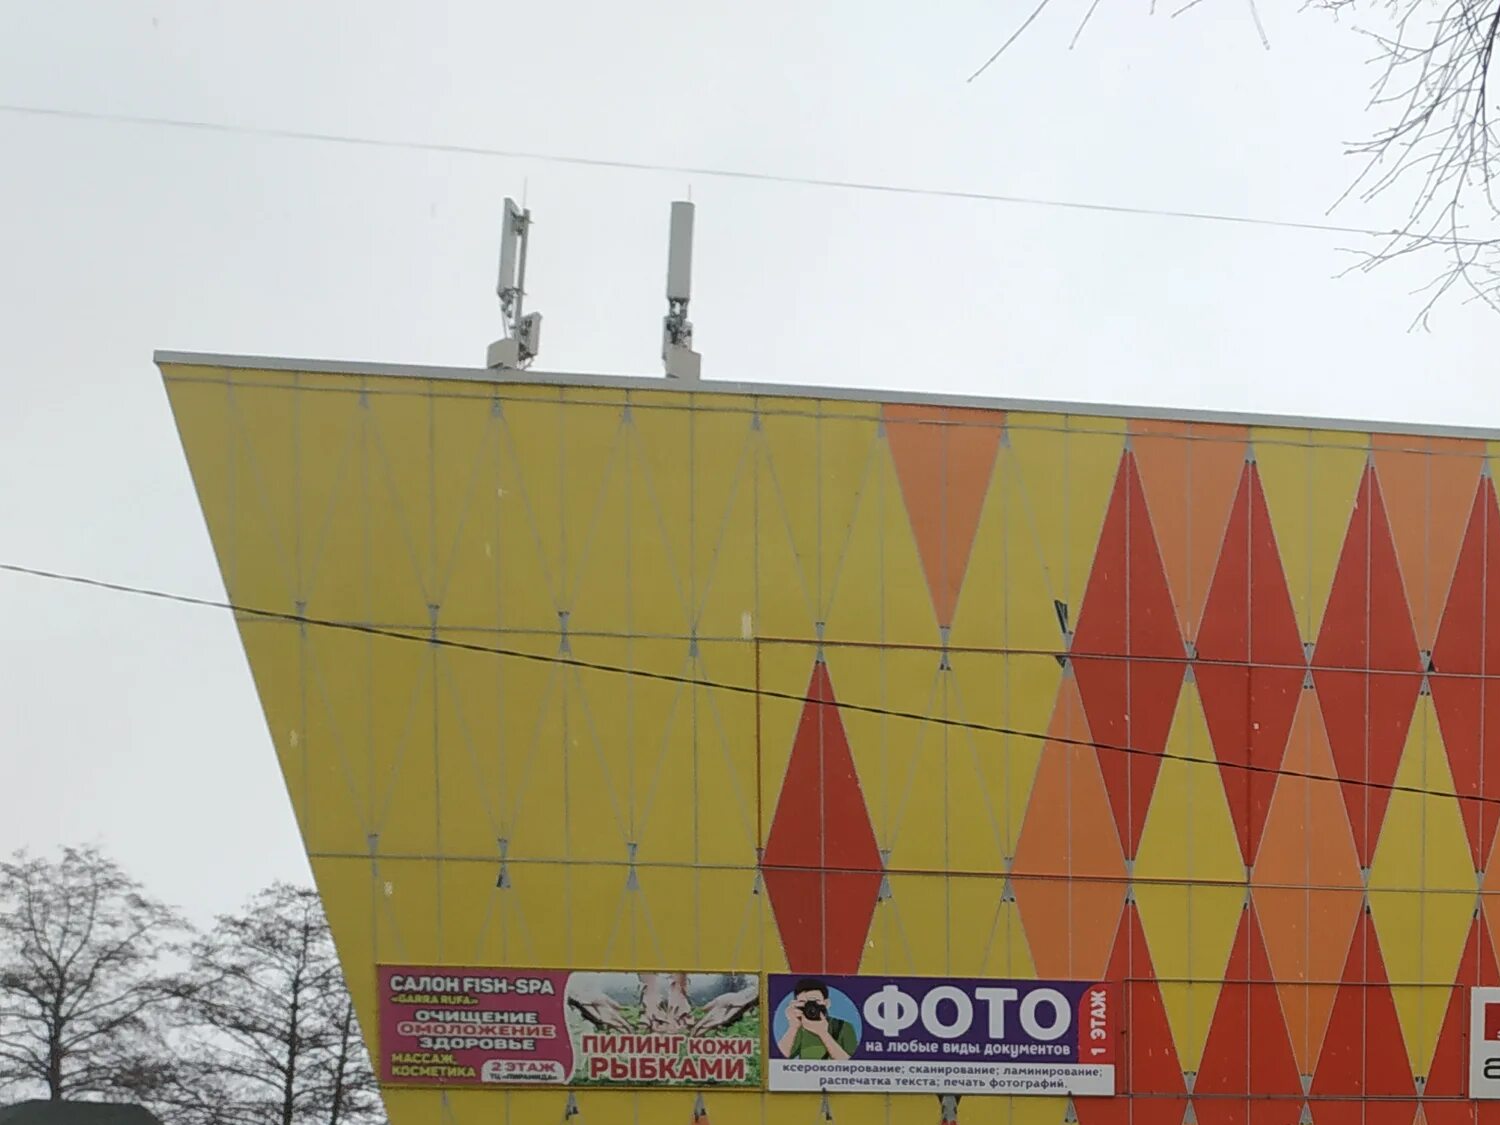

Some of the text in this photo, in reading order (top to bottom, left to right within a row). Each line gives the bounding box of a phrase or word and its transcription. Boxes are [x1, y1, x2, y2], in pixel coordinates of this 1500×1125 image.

[389, 975, 555, 995] САЛОН FISH-SPA
[415, 1009, 538, 1024] ОЧИЩЕНИЕ
[863, 985, 1072, 1041] ФОТО
[1090, 990, 1107, 1055] 1 ЭТАЖ
[399, 1023, 555, 1038] ОМОЛОЖЕНИЕ
[419, 1037, 535, 1050] ЗДОРОВЬЕ
[582, 1034, 752, 1055] ПИЛИНГ КОЖИ
[866, 1040, 1071, 1057] на любые виды документов
[391, 1053, 457, 1066] МАССАЖ,
[391, 1065, 476, 1077] КОСМЕТИКА
[491, 1062, 555, 1073] 2 ЭТАЖ
[590, 1056, 745, 1080] РЫБКАМИ
[782, 1064, 1103, 1079] ксерокопирование; сканирование; ламинирование;
[819, 1077, 1068, 1092] распечатка текста; печать фотографий.
